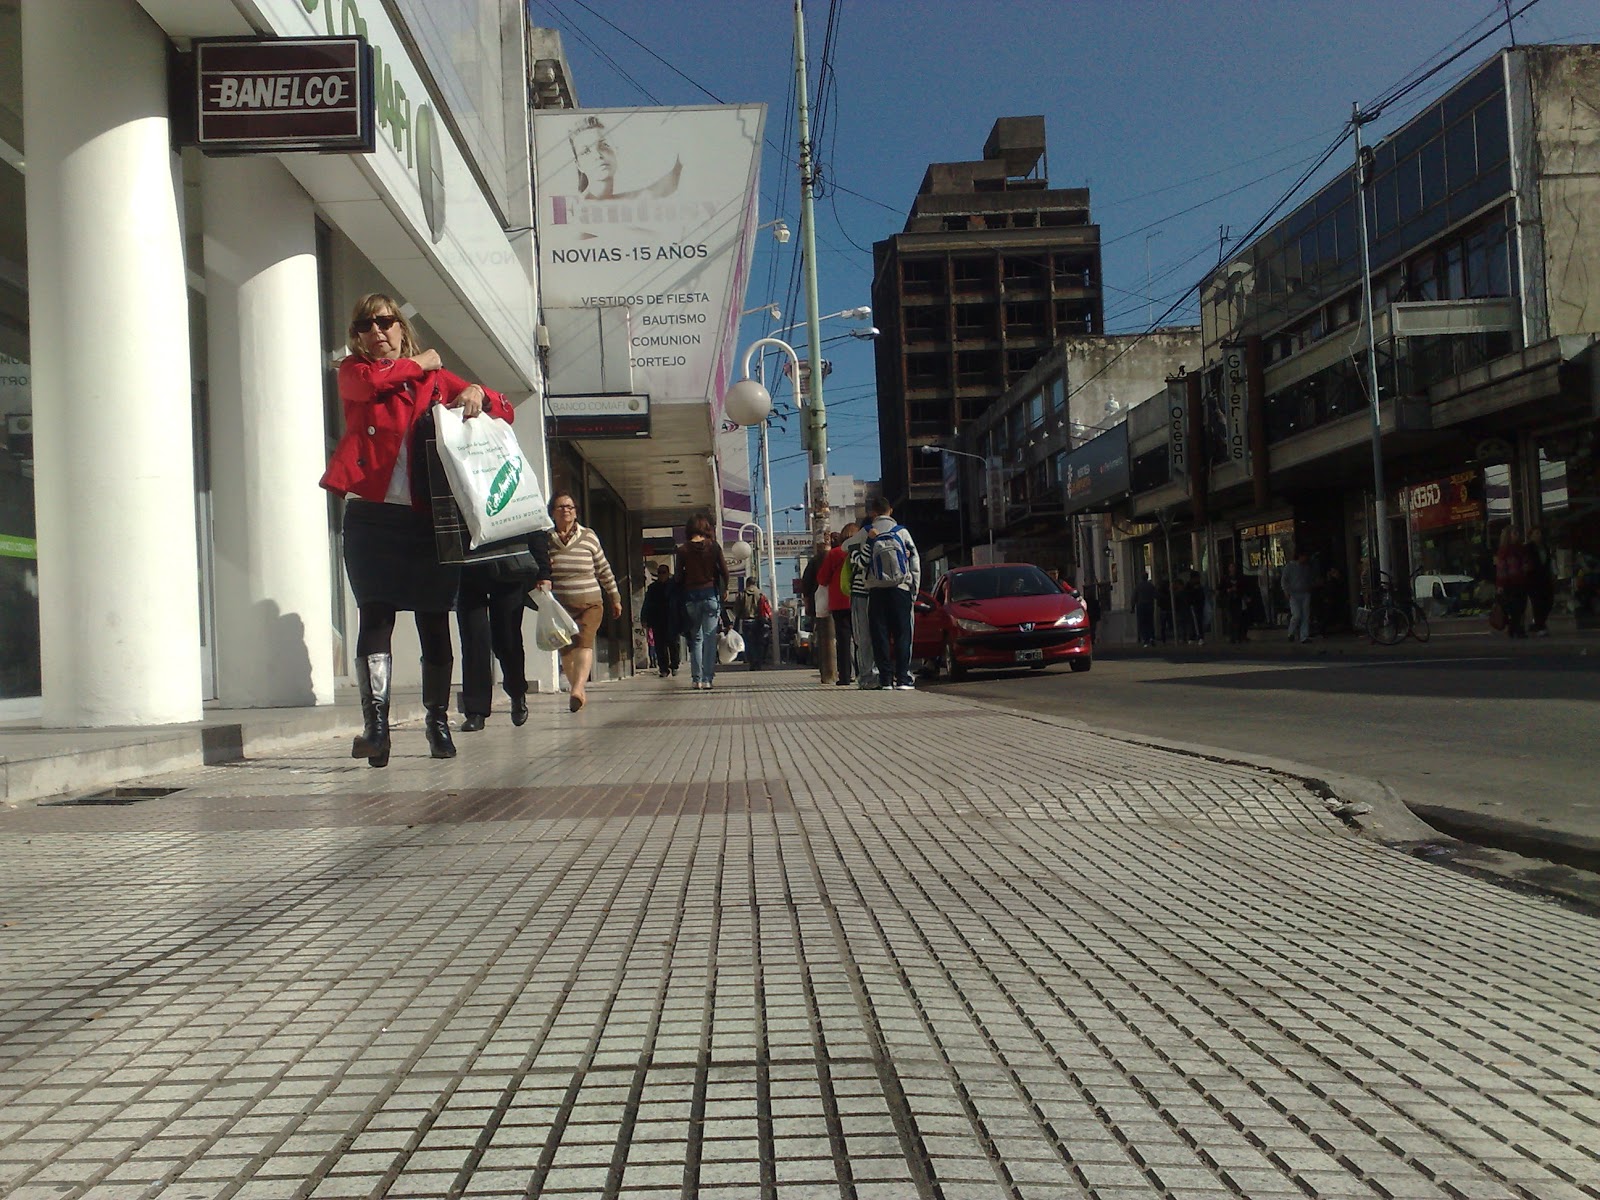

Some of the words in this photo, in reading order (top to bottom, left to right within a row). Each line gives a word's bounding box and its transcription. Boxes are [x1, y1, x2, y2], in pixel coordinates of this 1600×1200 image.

[217, 74, 345, 109] BANELCO
[551, 247, 622, 264] NOVIAS
[656, 242, 709, 260] AÑOS
[581, 296, 644, 307] VESTIDOS
[646, 295, 663, 305] DE
[666, 292, 710, 303] FIESTA
[642, 313, 707, 326] BAUTISMO
[631, 335, 701, 347] COMUNION
[630, 355, 687, 368] CORTEJO
[553, 401, 587, 411] BANCO
[588, 401, 626, 411] COMAFI
[1171, 406, 1185, 465] Ocean
